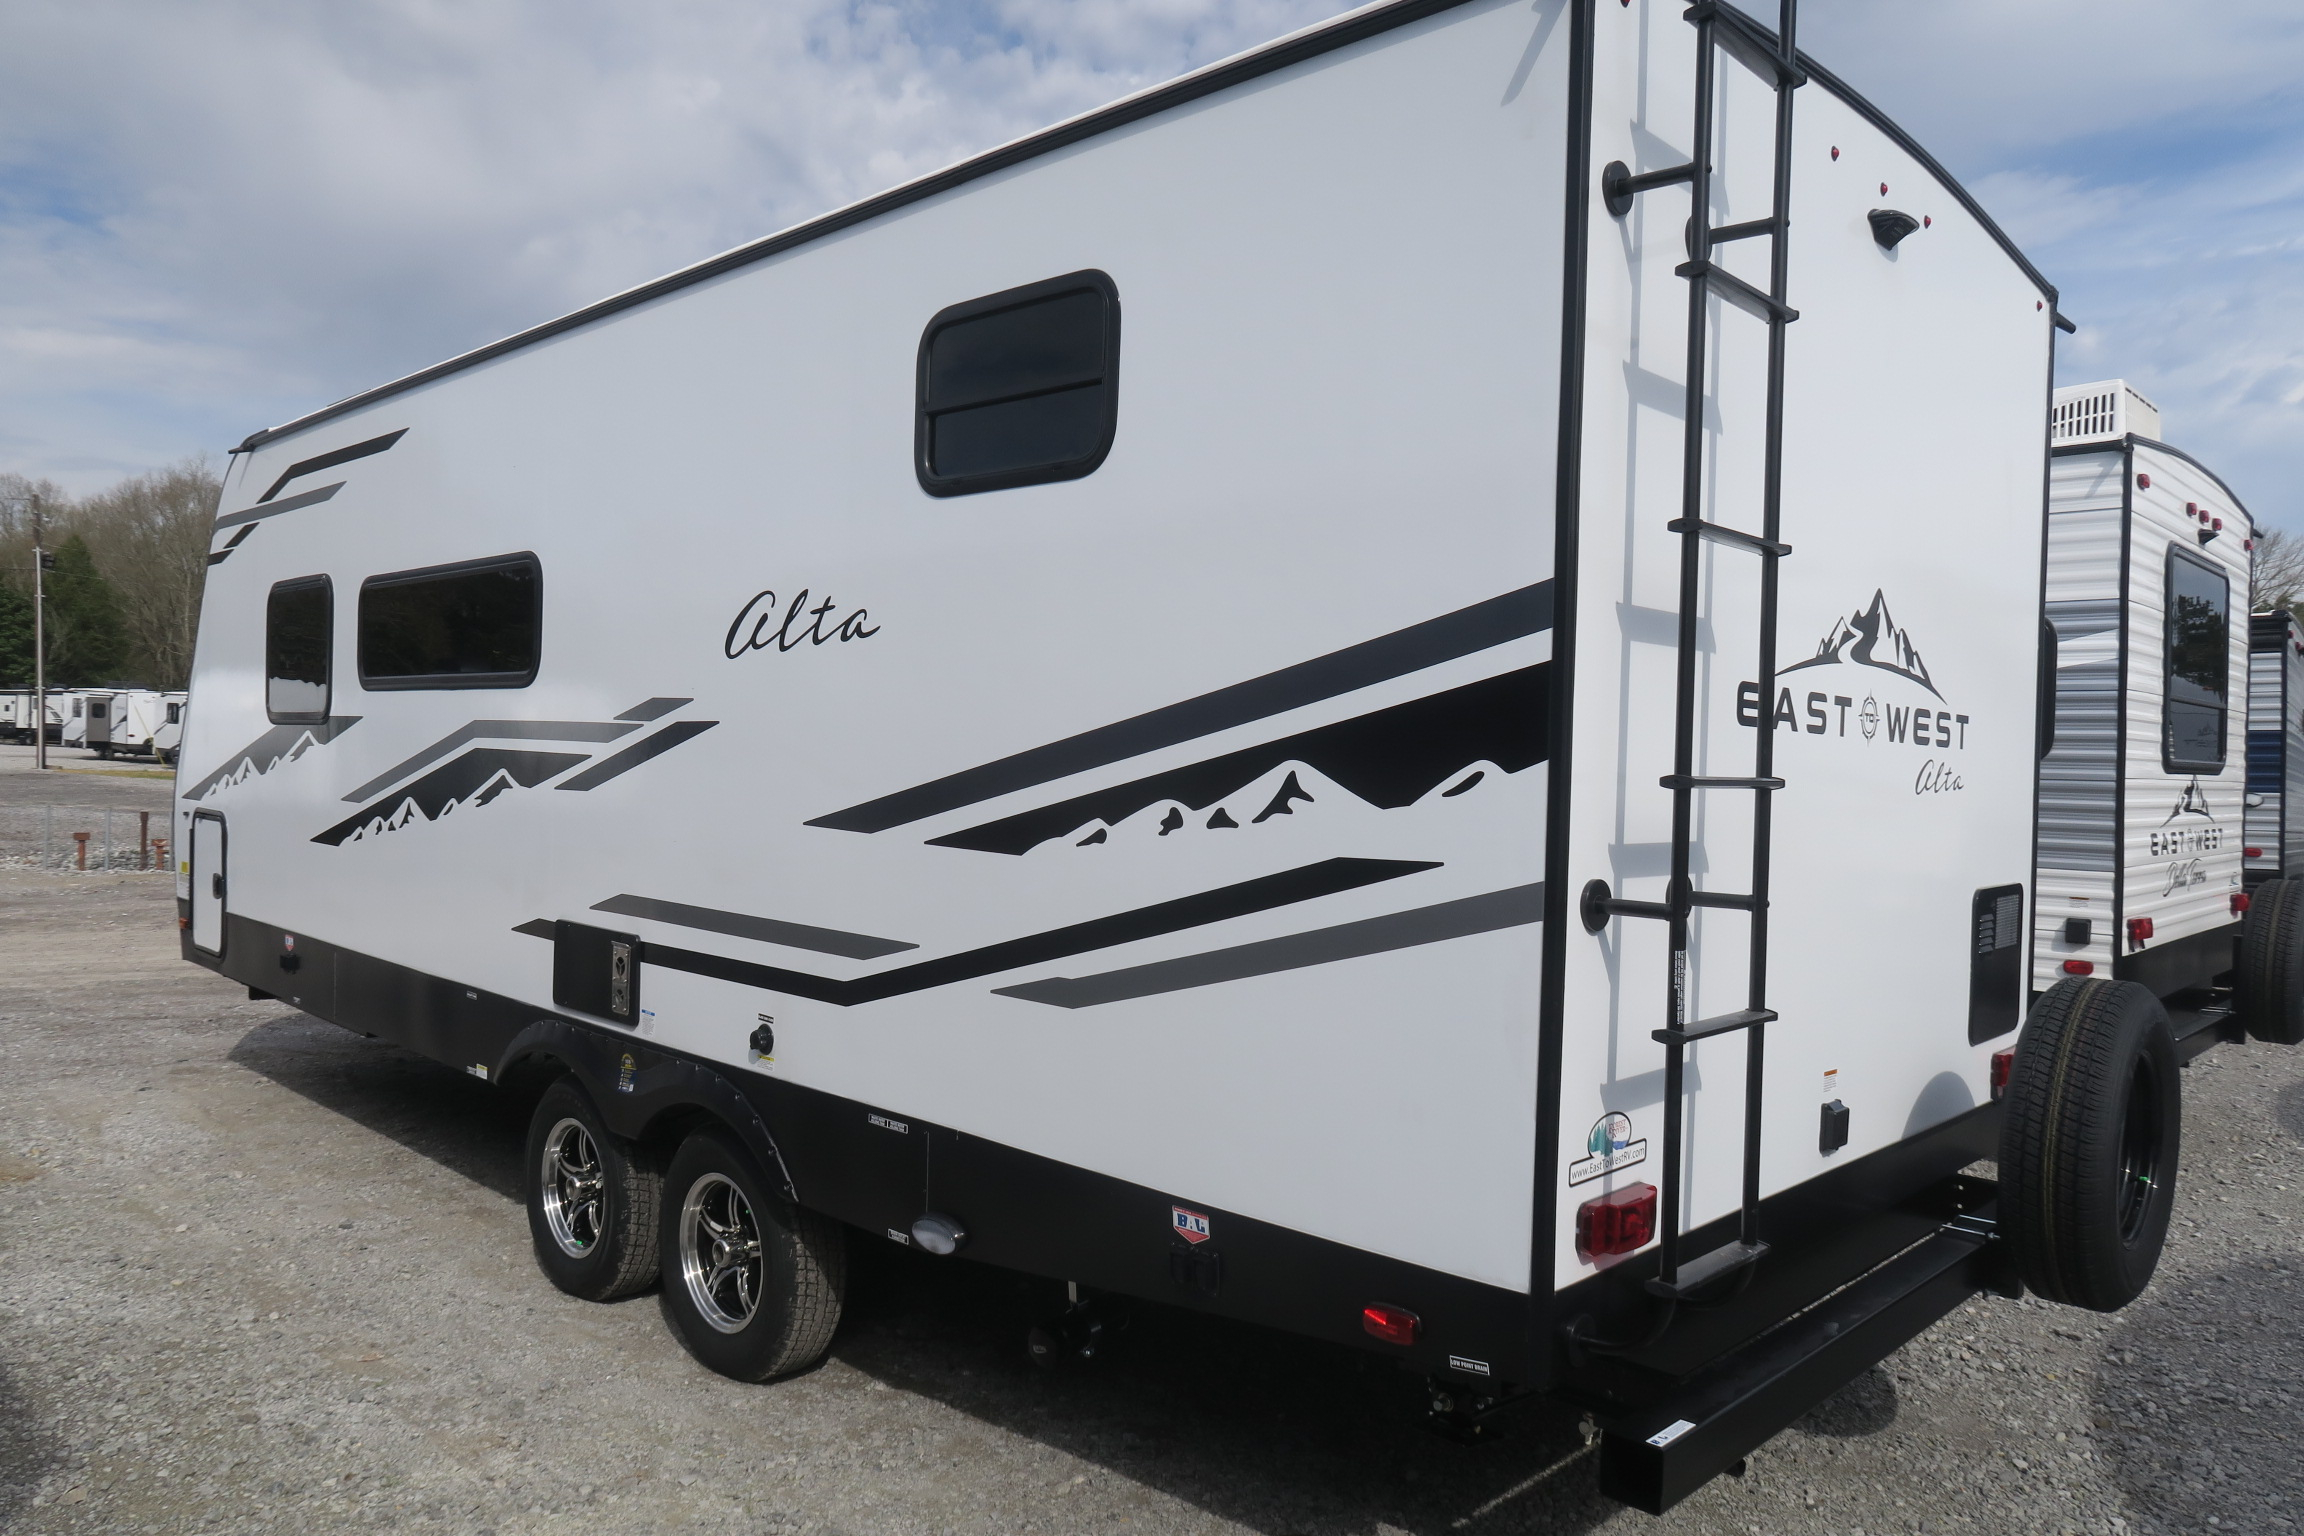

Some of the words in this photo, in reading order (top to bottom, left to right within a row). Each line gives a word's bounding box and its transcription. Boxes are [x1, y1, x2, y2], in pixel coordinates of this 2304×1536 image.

[724, 588, 881, 660] Alta
[1736, 680, 1853, 738] EAST
[1886, 703, 1970, 750] WEST
[1915, 759, 1965, 795] Alta
[2150, 831, 2185, 856] EAST
[2194, 827, 2223, 851] WEST
[1571, 1146, 1645, 1180] www.EastToWestRV.com
